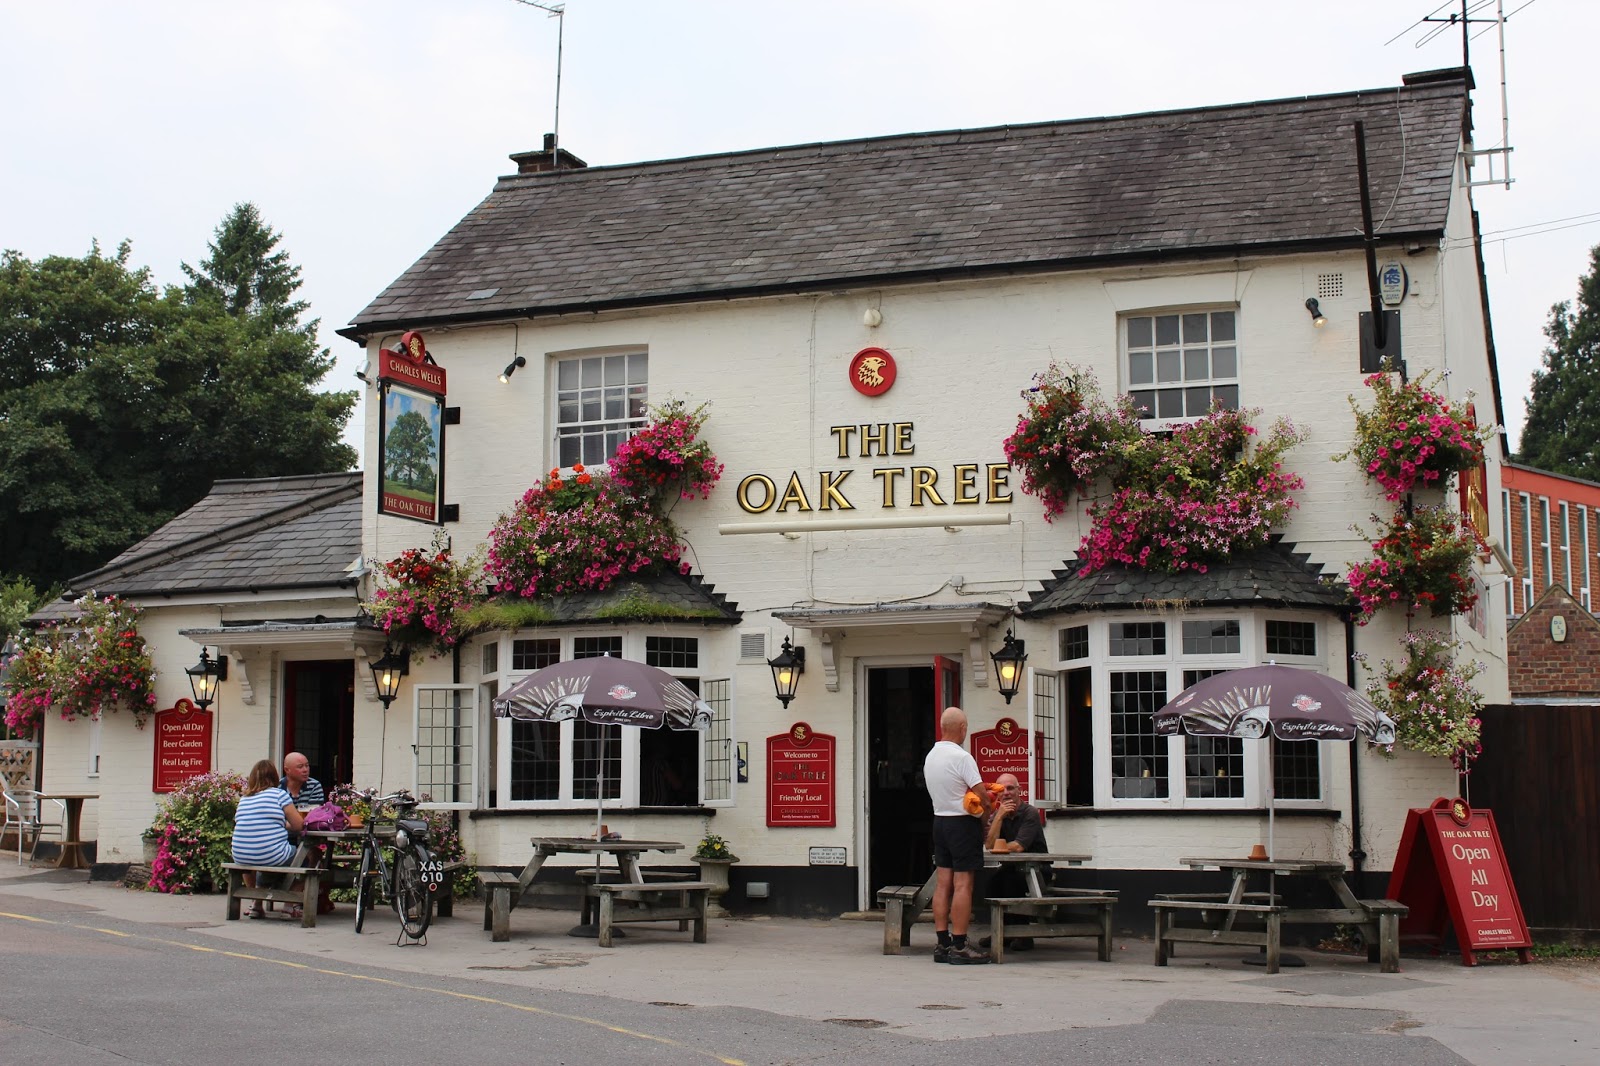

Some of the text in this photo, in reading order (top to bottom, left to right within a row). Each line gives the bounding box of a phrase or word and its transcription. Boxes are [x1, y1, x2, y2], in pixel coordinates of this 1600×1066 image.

[389, 360, 441, 385] CHARLES WELLS
[831, 422, 915, 458] THE
[736, 462, 1013, 514] OAK TREE
[384, 496, 432, 515] THE OAK TREE
[162, 723, 204, 732] Open All Day
[1281, 721, 1345, 733] Espiritu Libre
[163, 740, 203, 748] Beer Garden
[980, 746, 1029, 757] Open All Da
[162, 758, 203, 767] Real Log Fire
[779, 794, 804, 802] Friendly
[1452, 844, 1491, 864] Open
[420, 861, 443, 871] XAS
[421, 872, 443, 882] 610
[1471, 869, 1489, 886] All
[1471, 891, 1498, 911] Day
